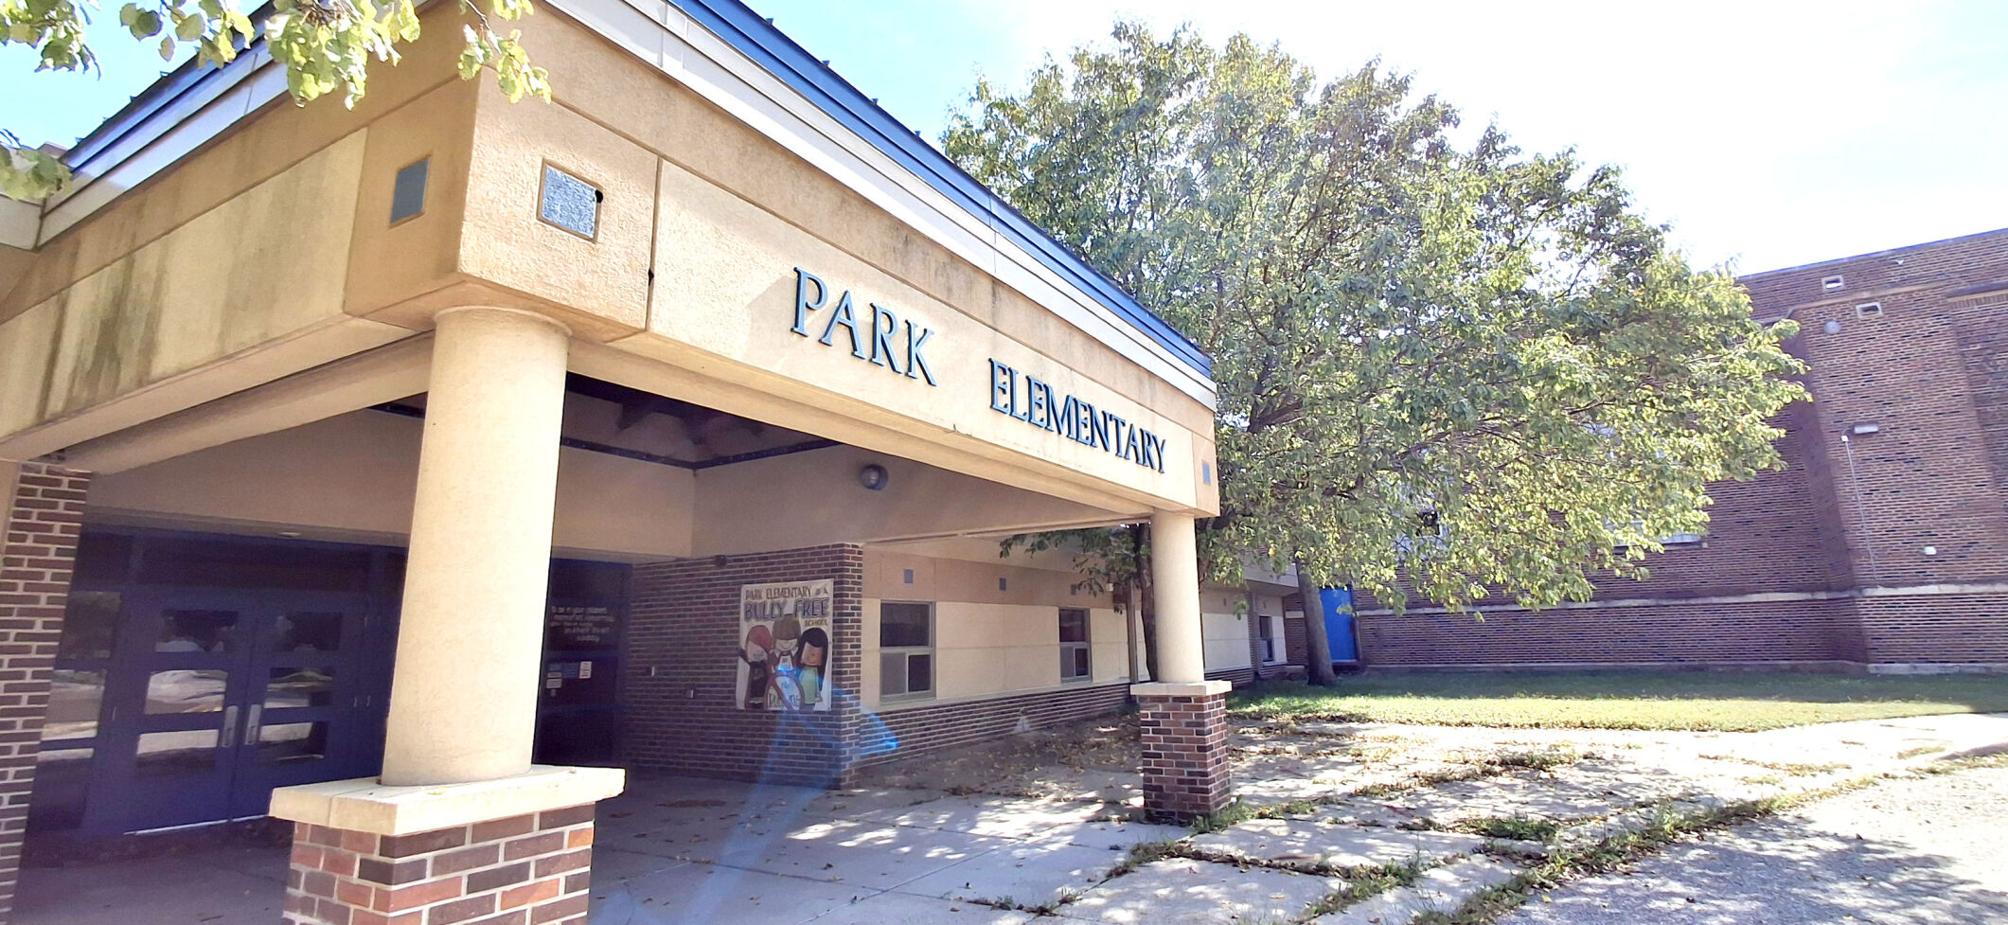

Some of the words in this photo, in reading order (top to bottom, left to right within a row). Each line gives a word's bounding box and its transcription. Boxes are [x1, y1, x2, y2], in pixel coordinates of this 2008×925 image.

[791, 265, 938, 387] PARK
[988, 357, 1167, 474] ELEMENTARY
[745, 588, 763, 600] PARK
[766, 585, 811, 600] ELEMENTARY
[745, 599, 787, 621] BULLY
[794, 597, 830, 617] FREE
[805, 619, 828, 627] SCHOOL
